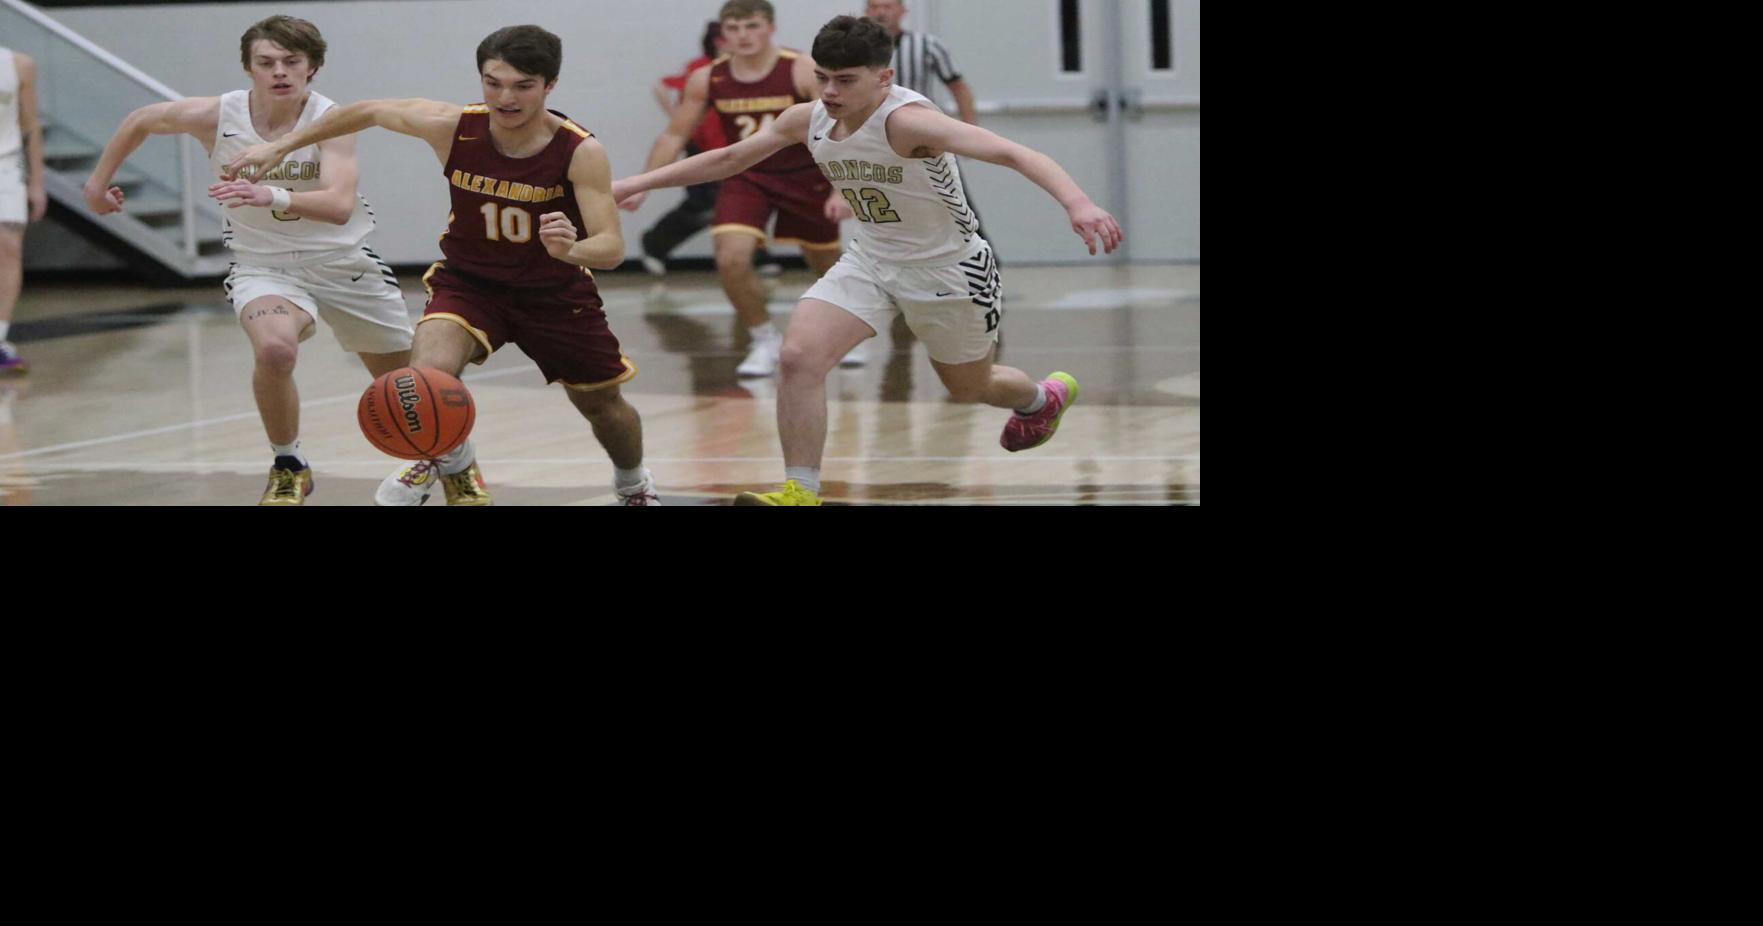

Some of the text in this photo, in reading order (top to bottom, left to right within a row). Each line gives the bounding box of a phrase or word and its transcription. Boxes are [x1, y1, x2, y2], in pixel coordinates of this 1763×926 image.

[451, 169, 565, 203] ALEXANDRIA
[480, 201, 532, 244] 10
[841, 187, 901, 224] 12
[984, 307, 1000, 334] D
[394, 373, 422, 433] Wilson
